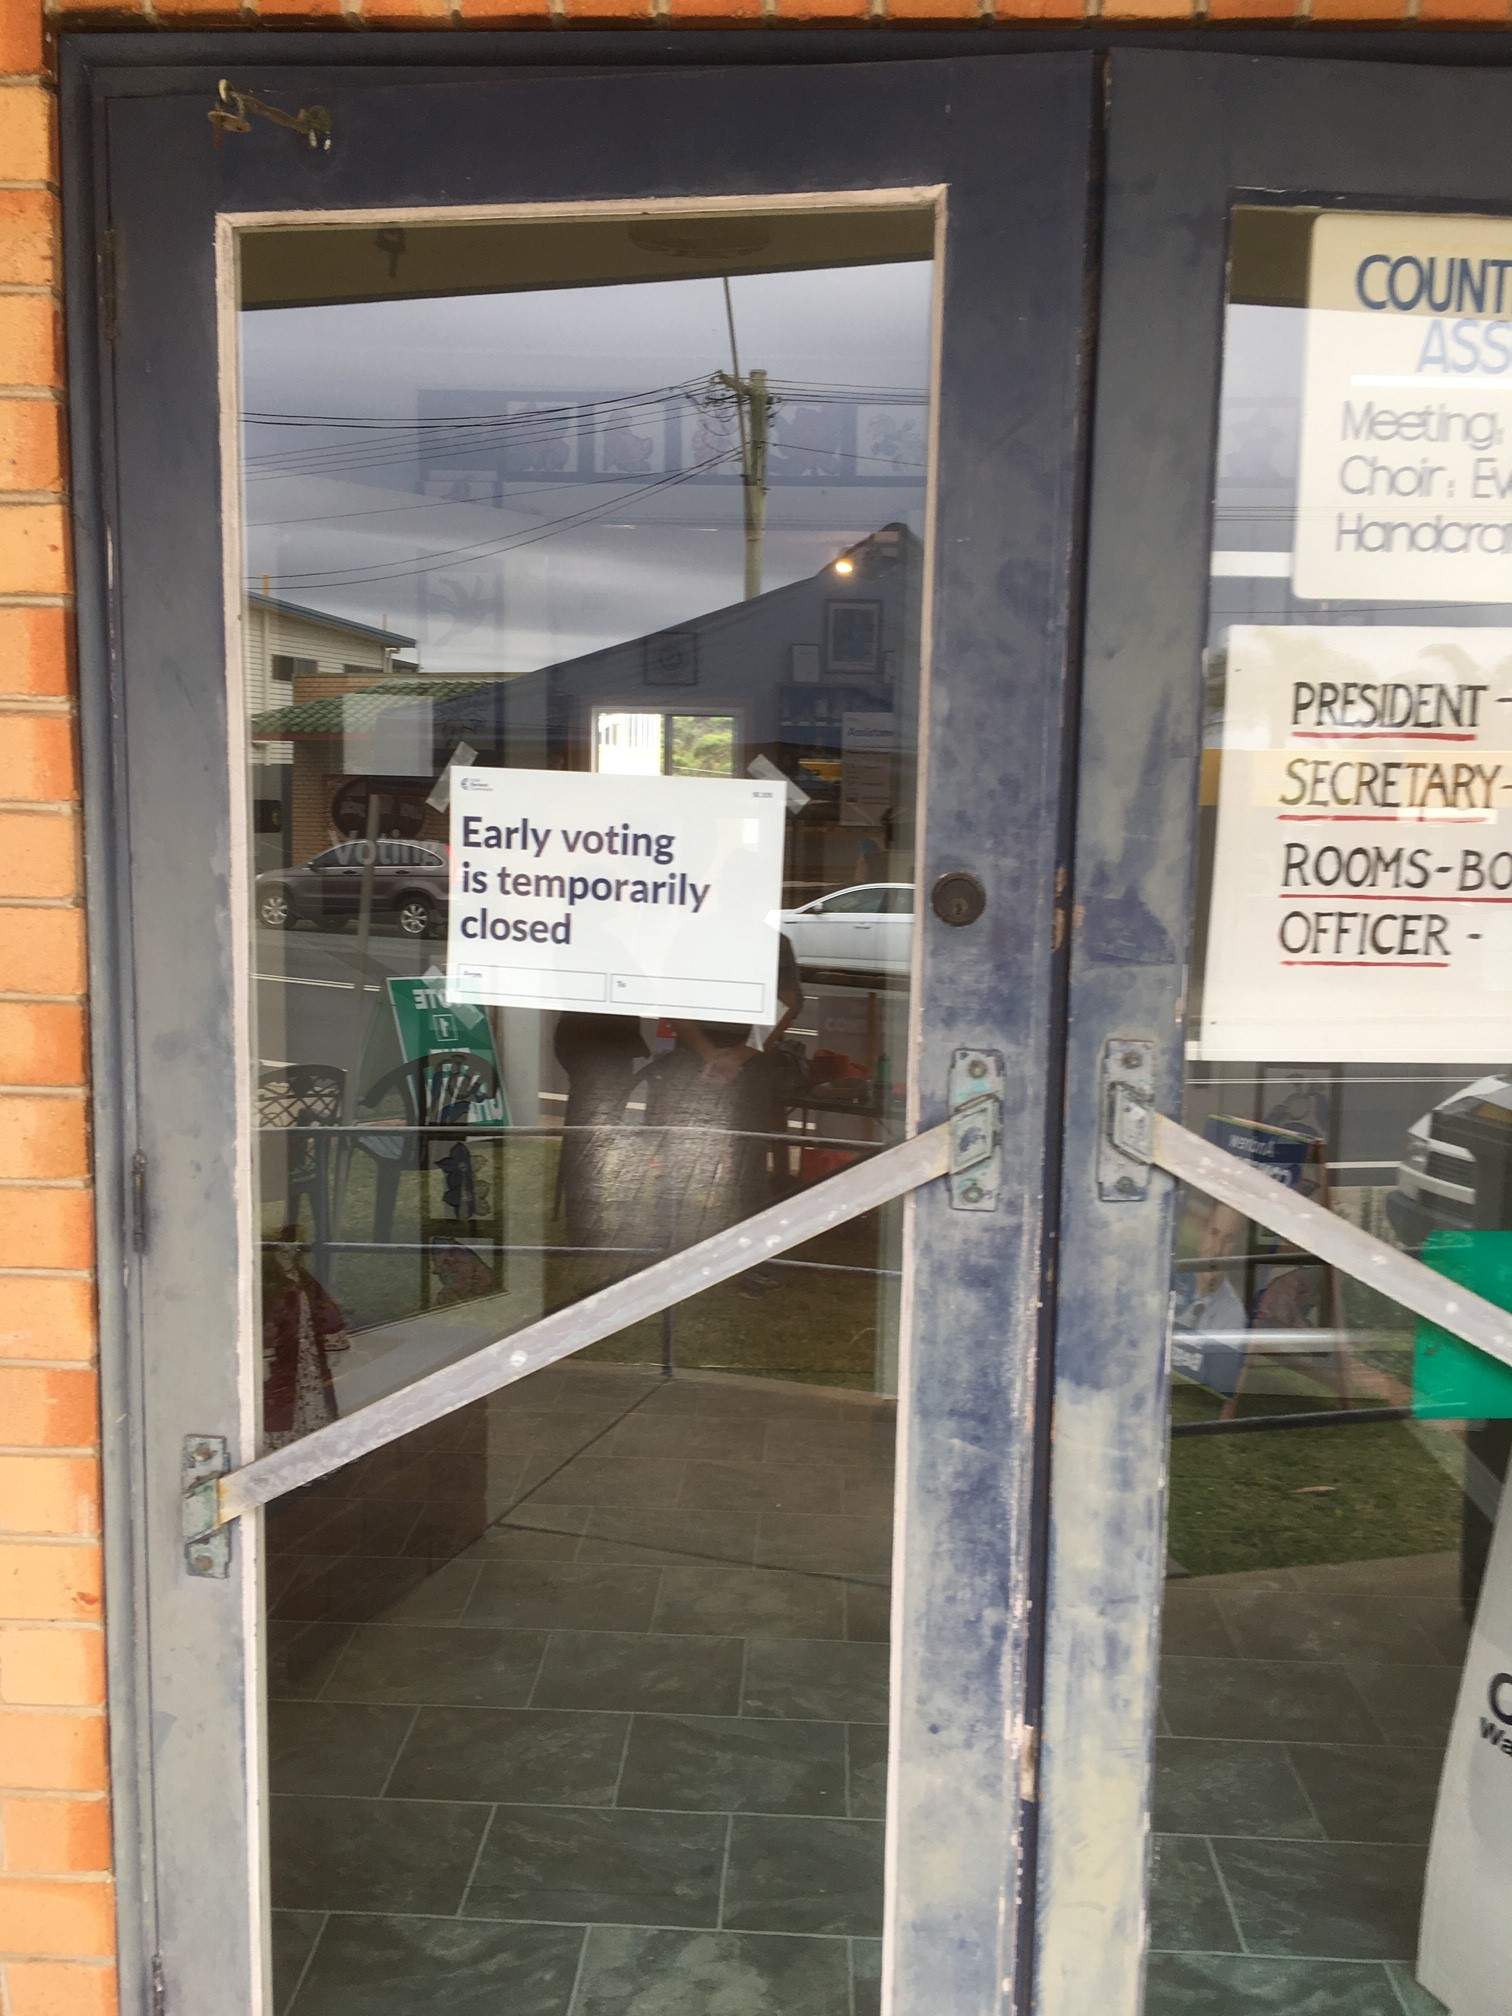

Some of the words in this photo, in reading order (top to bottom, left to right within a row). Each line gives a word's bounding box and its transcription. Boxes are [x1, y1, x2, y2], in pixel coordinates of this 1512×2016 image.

[1415, 317, 1512, 375] ASS
[1292, 681, 1488, 729] PRESIDENT
[462, 815, 552, 858] Early
[561, 823, 676, 865] voting
[462, 861, 488, 894] is
[498, 866, 711, 913] temporarily
[460, 908, 572, 945] closed
[1279, 911, 1451, 956] OFFICER
